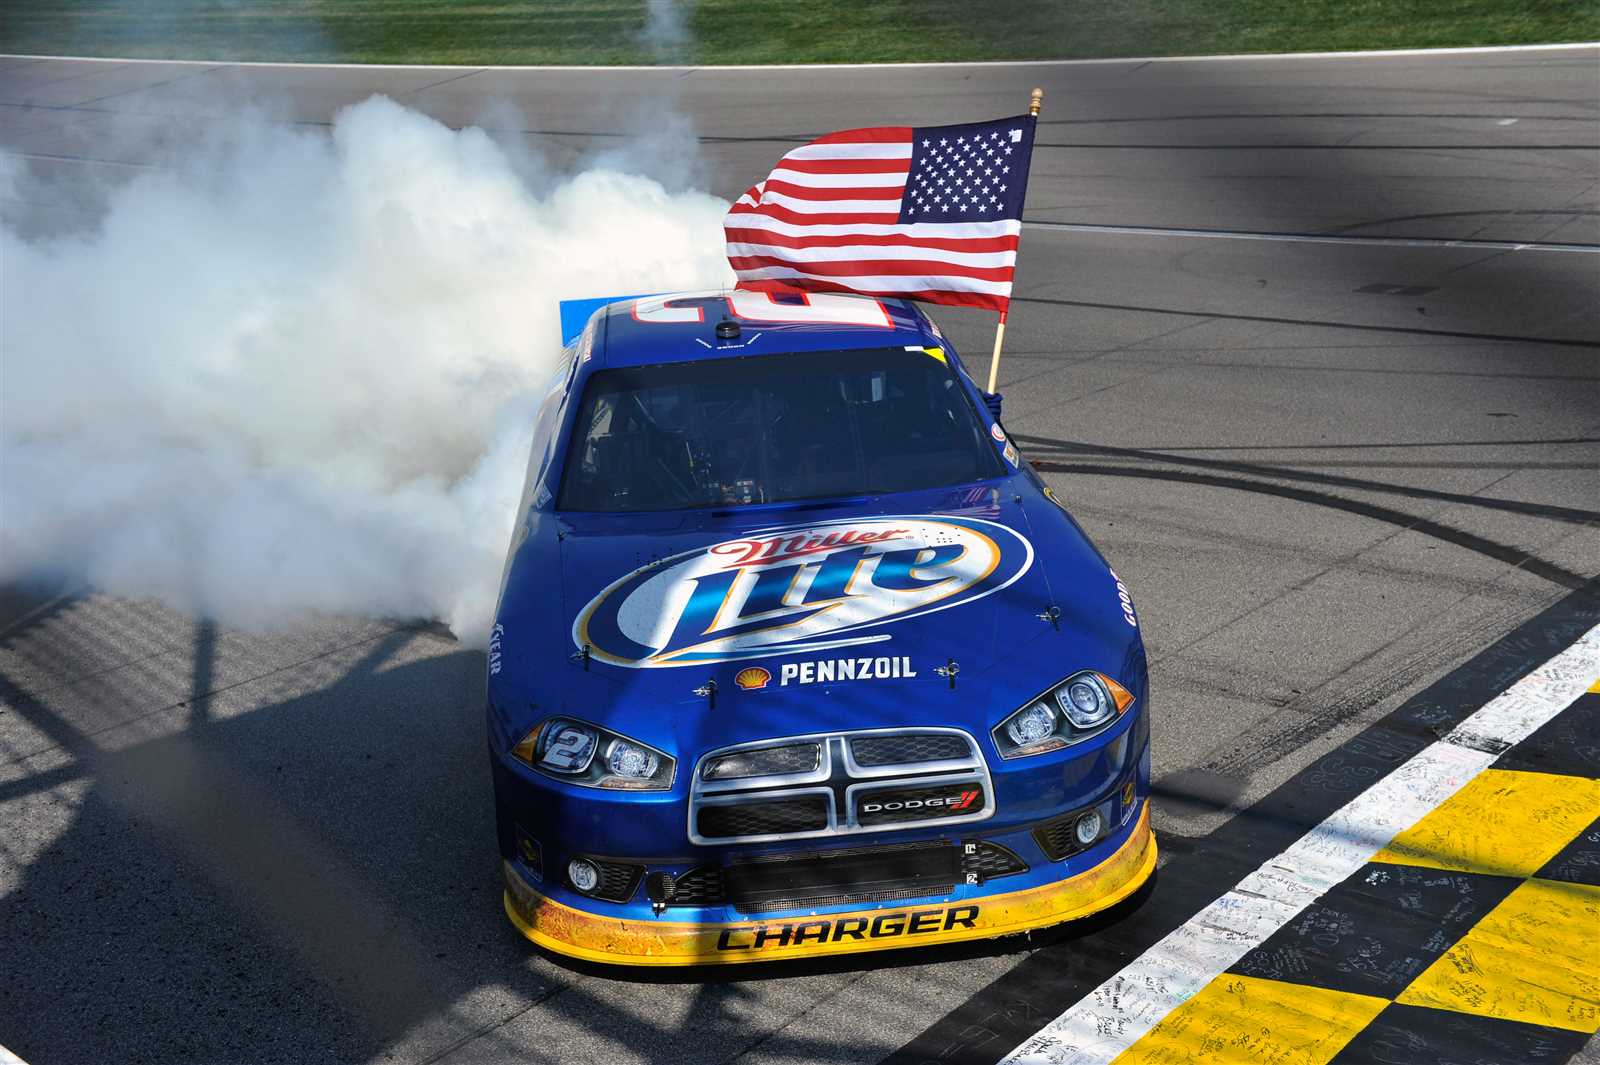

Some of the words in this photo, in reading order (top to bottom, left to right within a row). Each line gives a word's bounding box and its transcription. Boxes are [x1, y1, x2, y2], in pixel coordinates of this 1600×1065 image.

[710, 528, 910, 566] Miller
[648, 543, 968, 662] Lite
[781, 656, 916, 686] PENNZOIL
[542, 729, 589, 767] 2
[864, 797, 961, 812] DODGE
[717, 906, 979, 950] CHARGER
